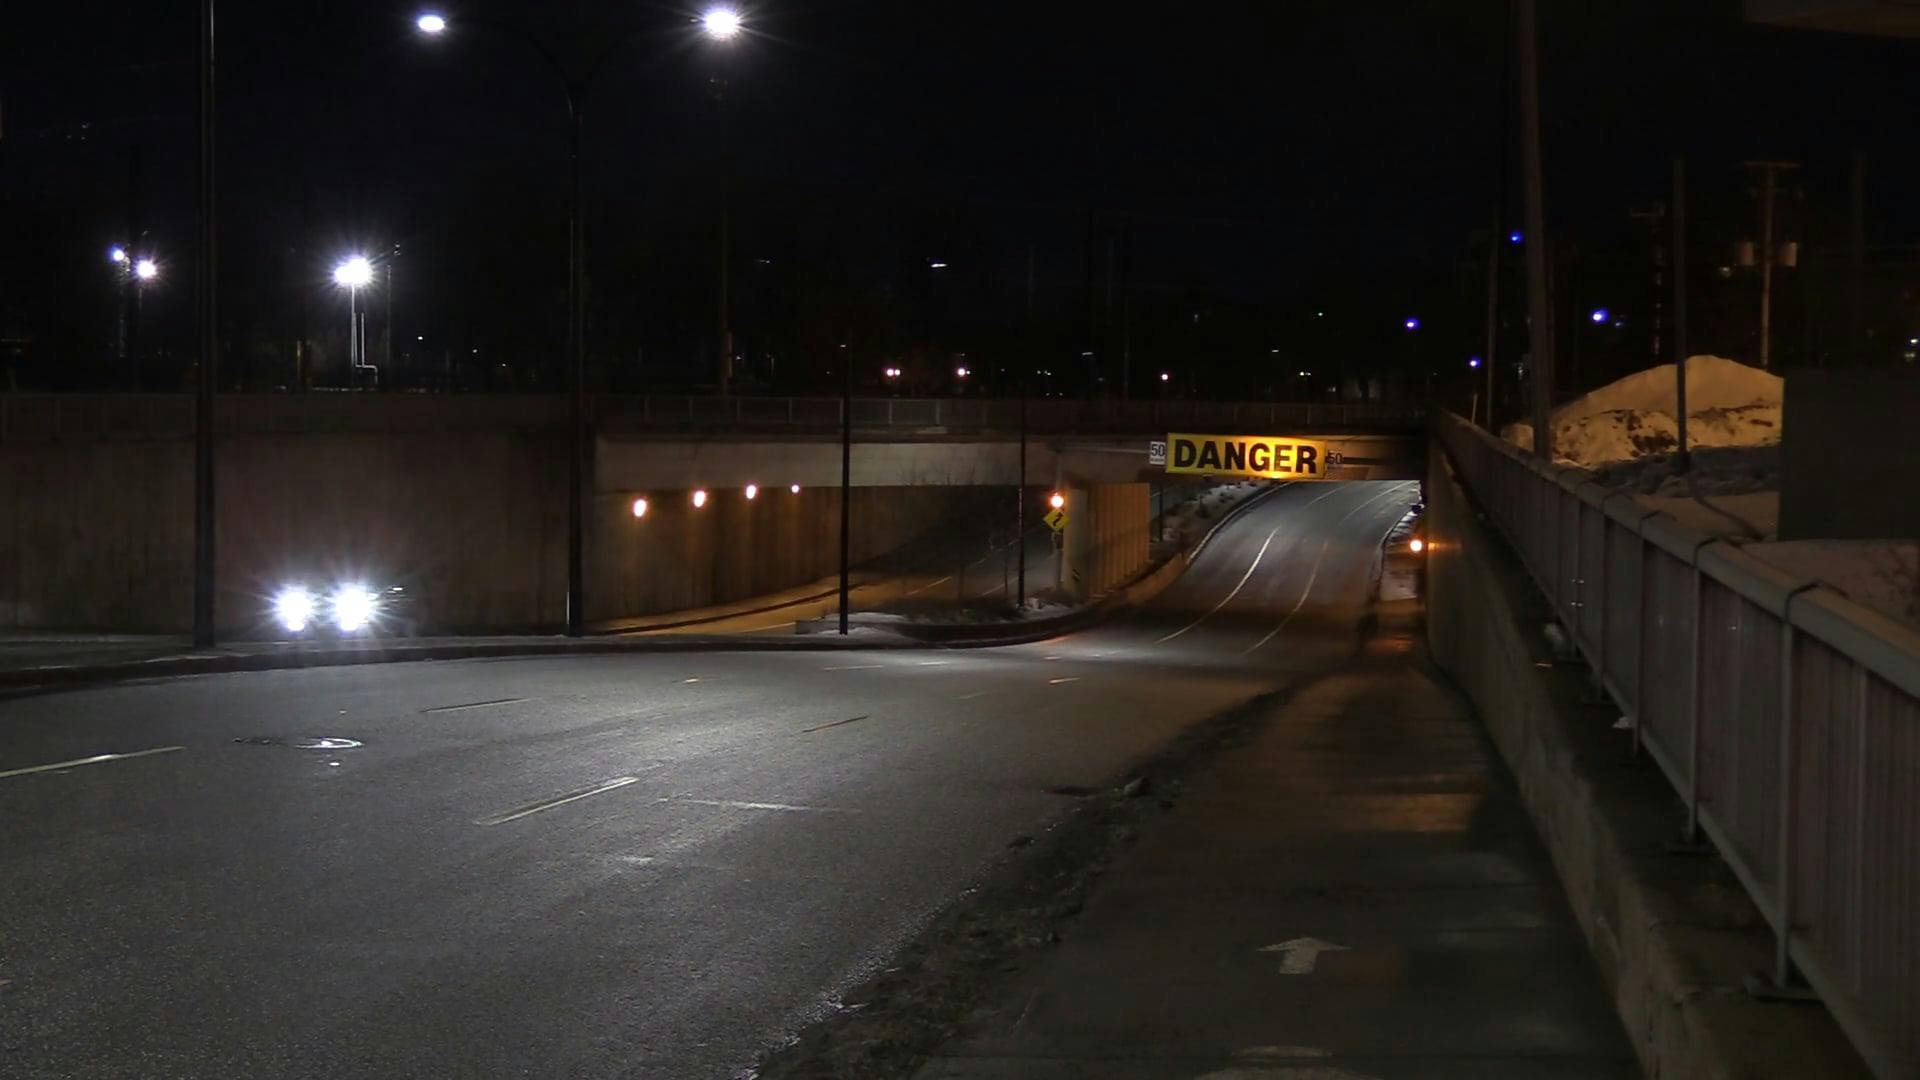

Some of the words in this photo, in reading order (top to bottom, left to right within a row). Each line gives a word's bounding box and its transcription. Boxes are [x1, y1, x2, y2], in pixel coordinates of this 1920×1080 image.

[1151, 444, 1165, 456] 50
[1174, 439, 1317, 474] DANGER
[1327, 452, 1343, 465] 50
